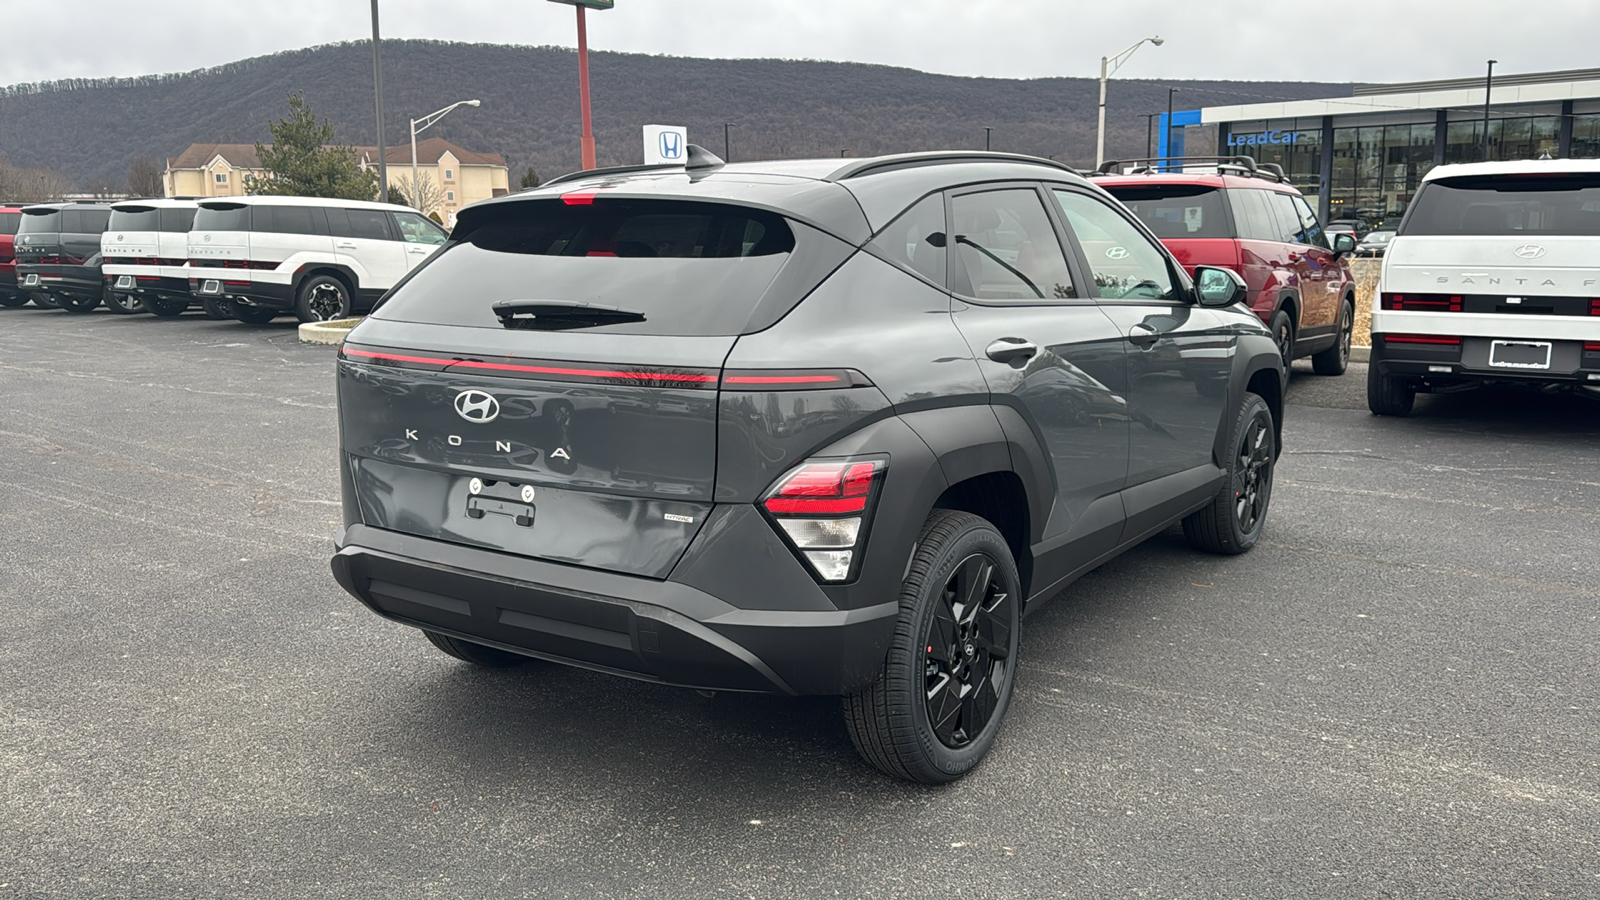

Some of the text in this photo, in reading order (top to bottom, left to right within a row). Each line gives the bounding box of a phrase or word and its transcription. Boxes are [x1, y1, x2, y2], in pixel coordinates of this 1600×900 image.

[1227, 129, 1299, 146] LeadCar
[1436, 276, 1555, 286] SANTA
[405, 428, 571, 460] KONA
